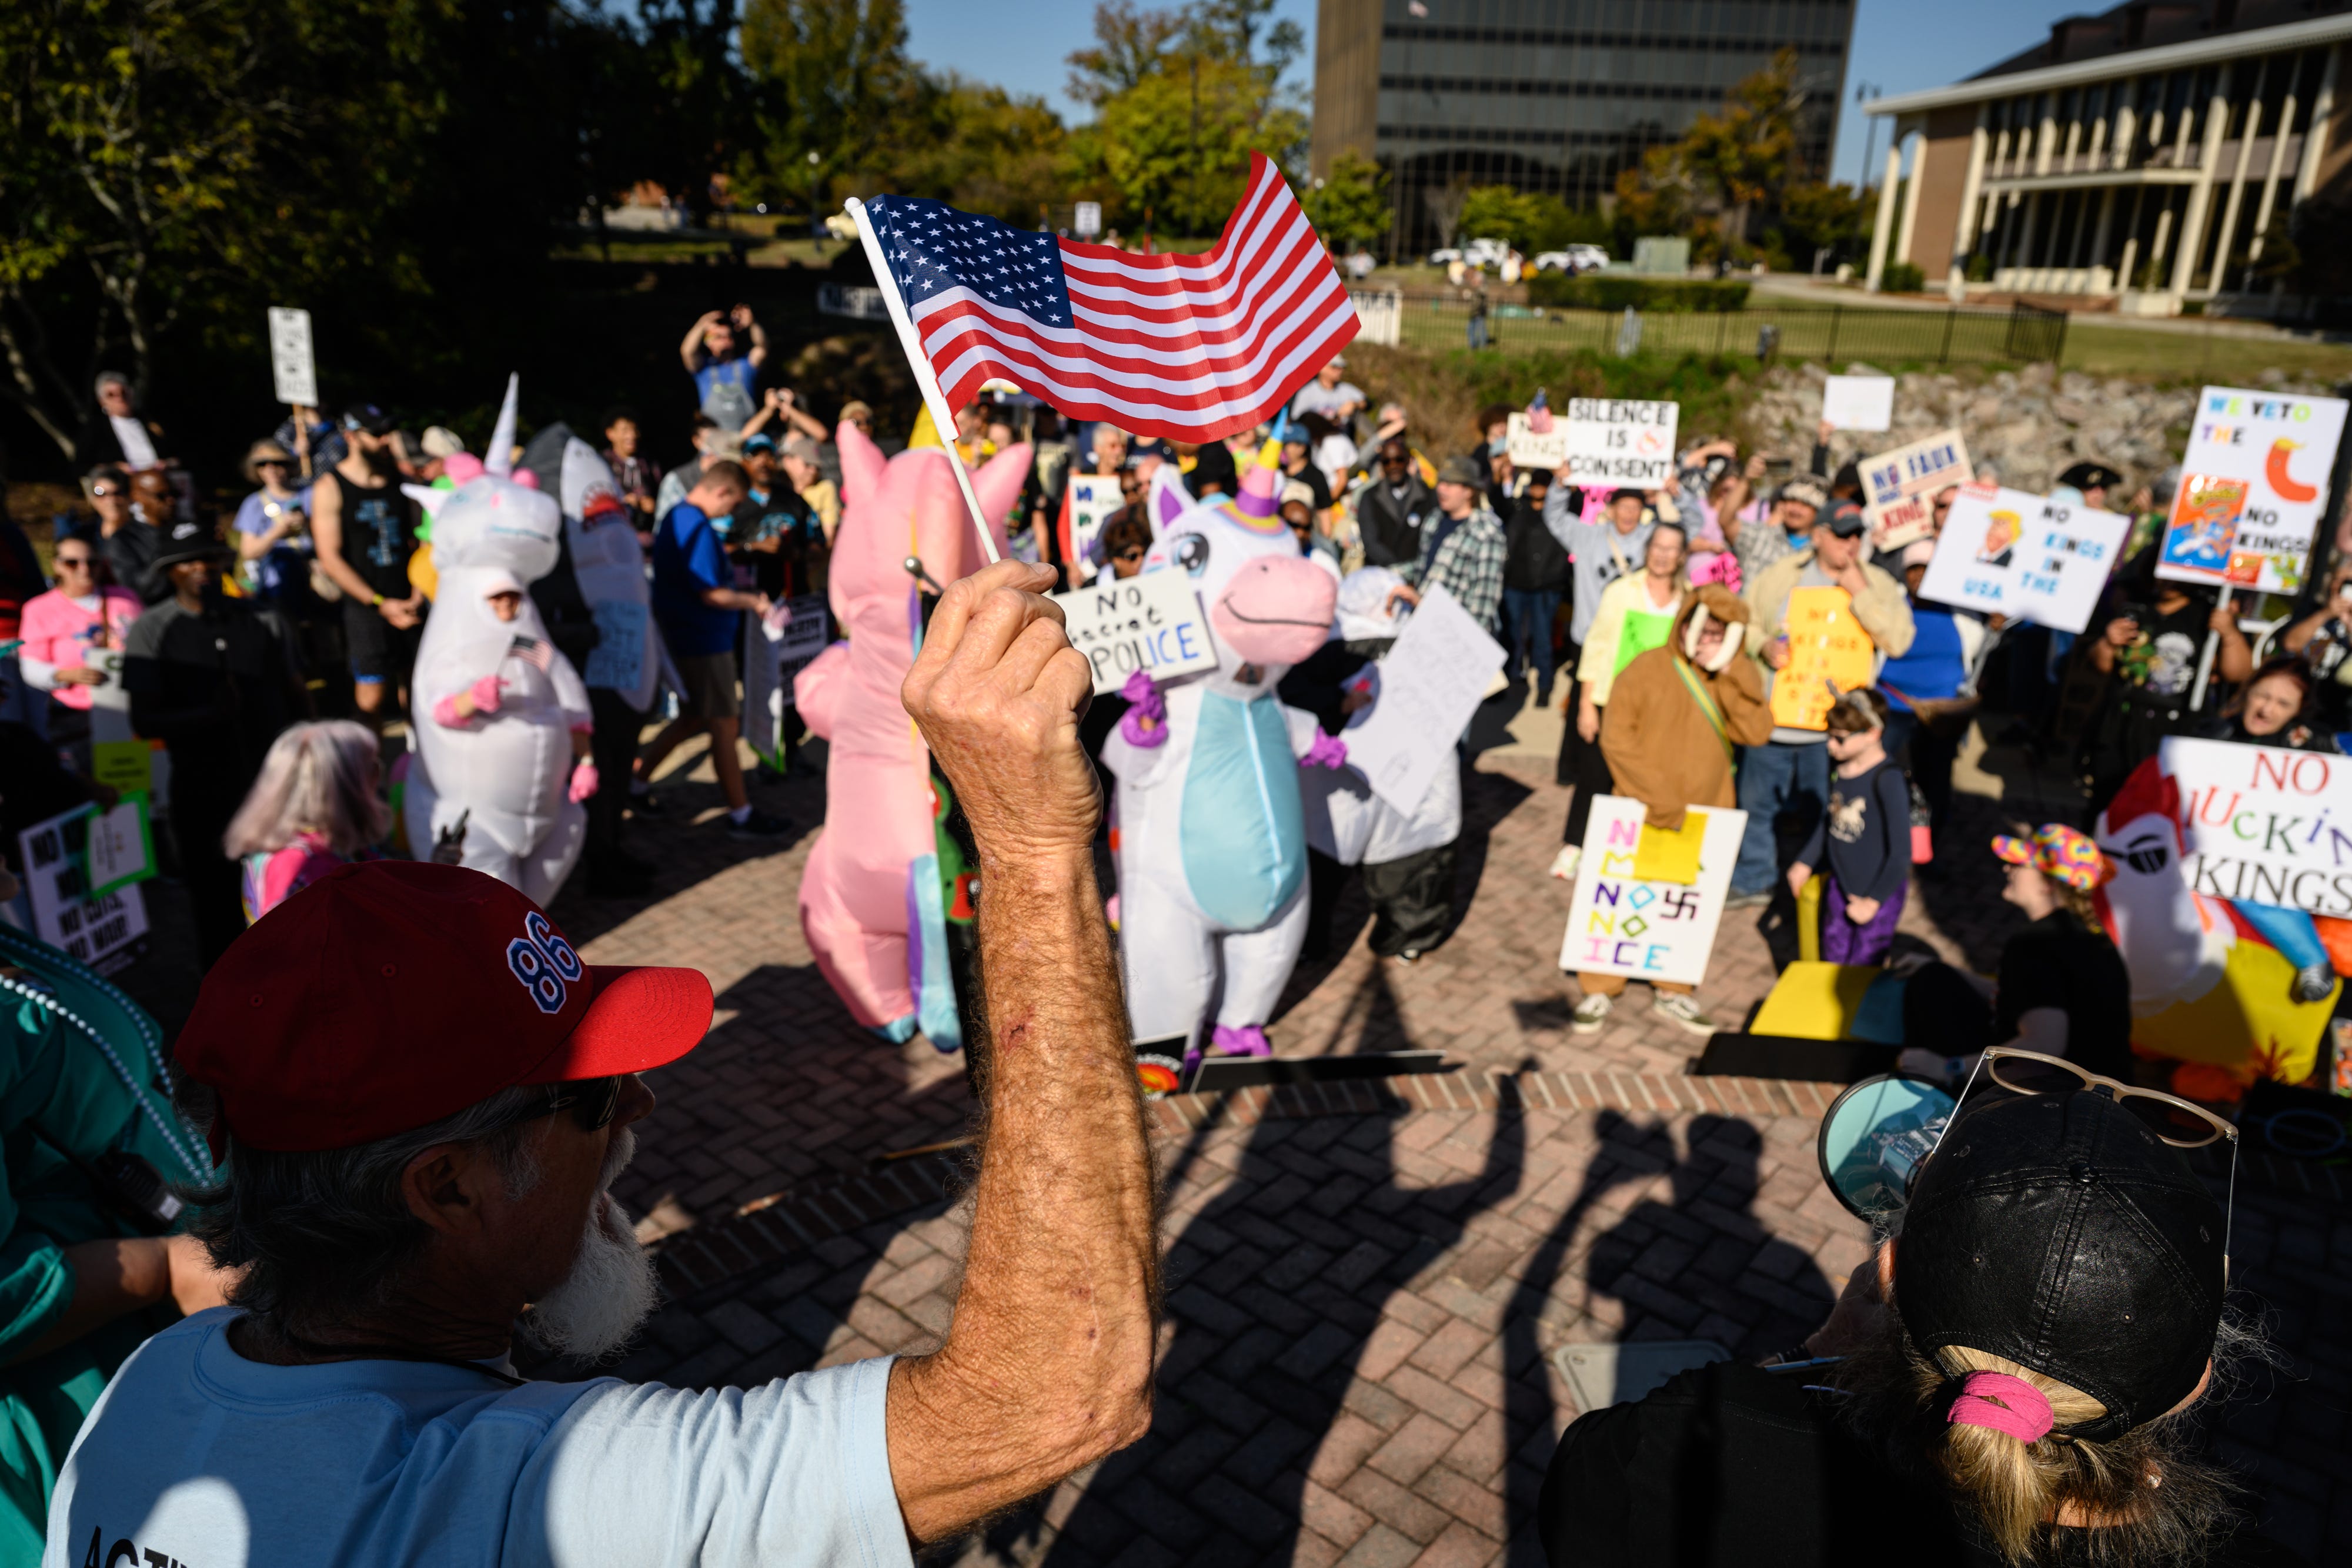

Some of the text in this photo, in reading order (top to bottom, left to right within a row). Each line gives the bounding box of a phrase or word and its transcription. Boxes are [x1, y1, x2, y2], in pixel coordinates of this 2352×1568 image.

[1573, 397, 1669, 426] SILENCE
[2208, 396, 2311, 423] WE VETO
[1605, 428, 1628, 449] IS
[2202, 423, 2244, 445] THE
[1568, 453, 1666, 478] CONSENT
[2042, 504, 2071, 523] NO
[2246, 506, 2278, 527] NO
[2044, 532, 2106, 561] KINGS
[1963, 577, 2003, 600] USA
[2021, 571, 2059, 595] THE
[1096, 586, 1142, 616] NO
[1090, 621, 1200, 683] POLICE
[2250, 750, 2330, 796] NO
[1593, 882, 1656, 910] NO
[2193, 854, 2352, 913] KINGS
[1587, 909, 1648, 937] NO
[506, 911, 582, 1014] 86
[1582, 937, 1671, 971] ICE
